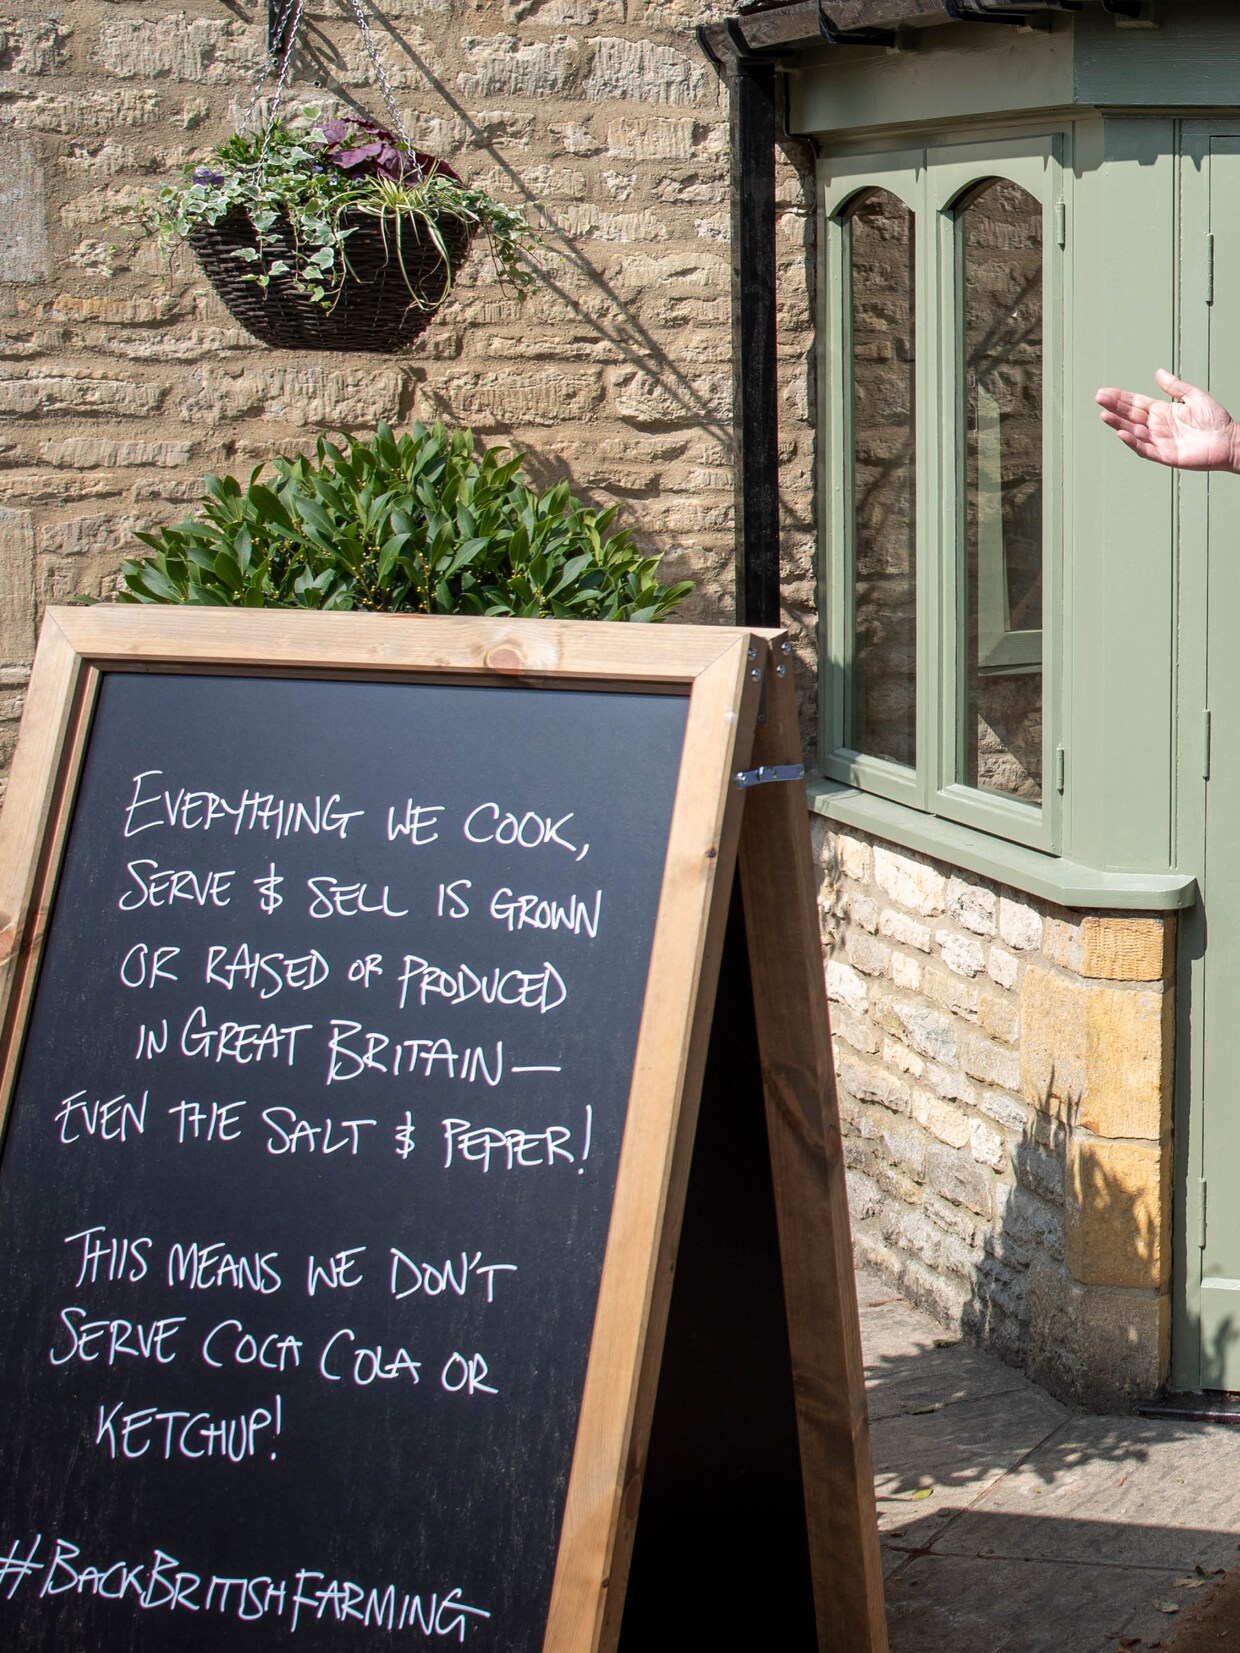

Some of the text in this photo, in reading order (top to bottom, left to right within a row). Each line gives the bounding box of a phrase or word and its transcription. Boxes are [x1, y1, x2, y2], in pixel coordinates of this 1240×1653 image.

[123, 769, 590, 862] EVERYTHING WE COOK,
[118, 858, 603, 939] SERVE & SELL IS GROWN
[120, 942, 568, 1014] OR RAISED OR PRODUCED
[135, 1018, 168, 1060] IN
[180, 1005, 314, 1066] GREAT
[54, 1089, 593, 1175] EVEN THE SALT & PEPPER!
[64, 1226, 518, 1303] THIS MEANS WE DON'T
[49, 1307, 499, 1395] SERVE COCA COLA OR
[95, 1394, 281, 1462] KETCHUP!
[0, 1534, 491, 1643] #BACKBRITISHFARMING
